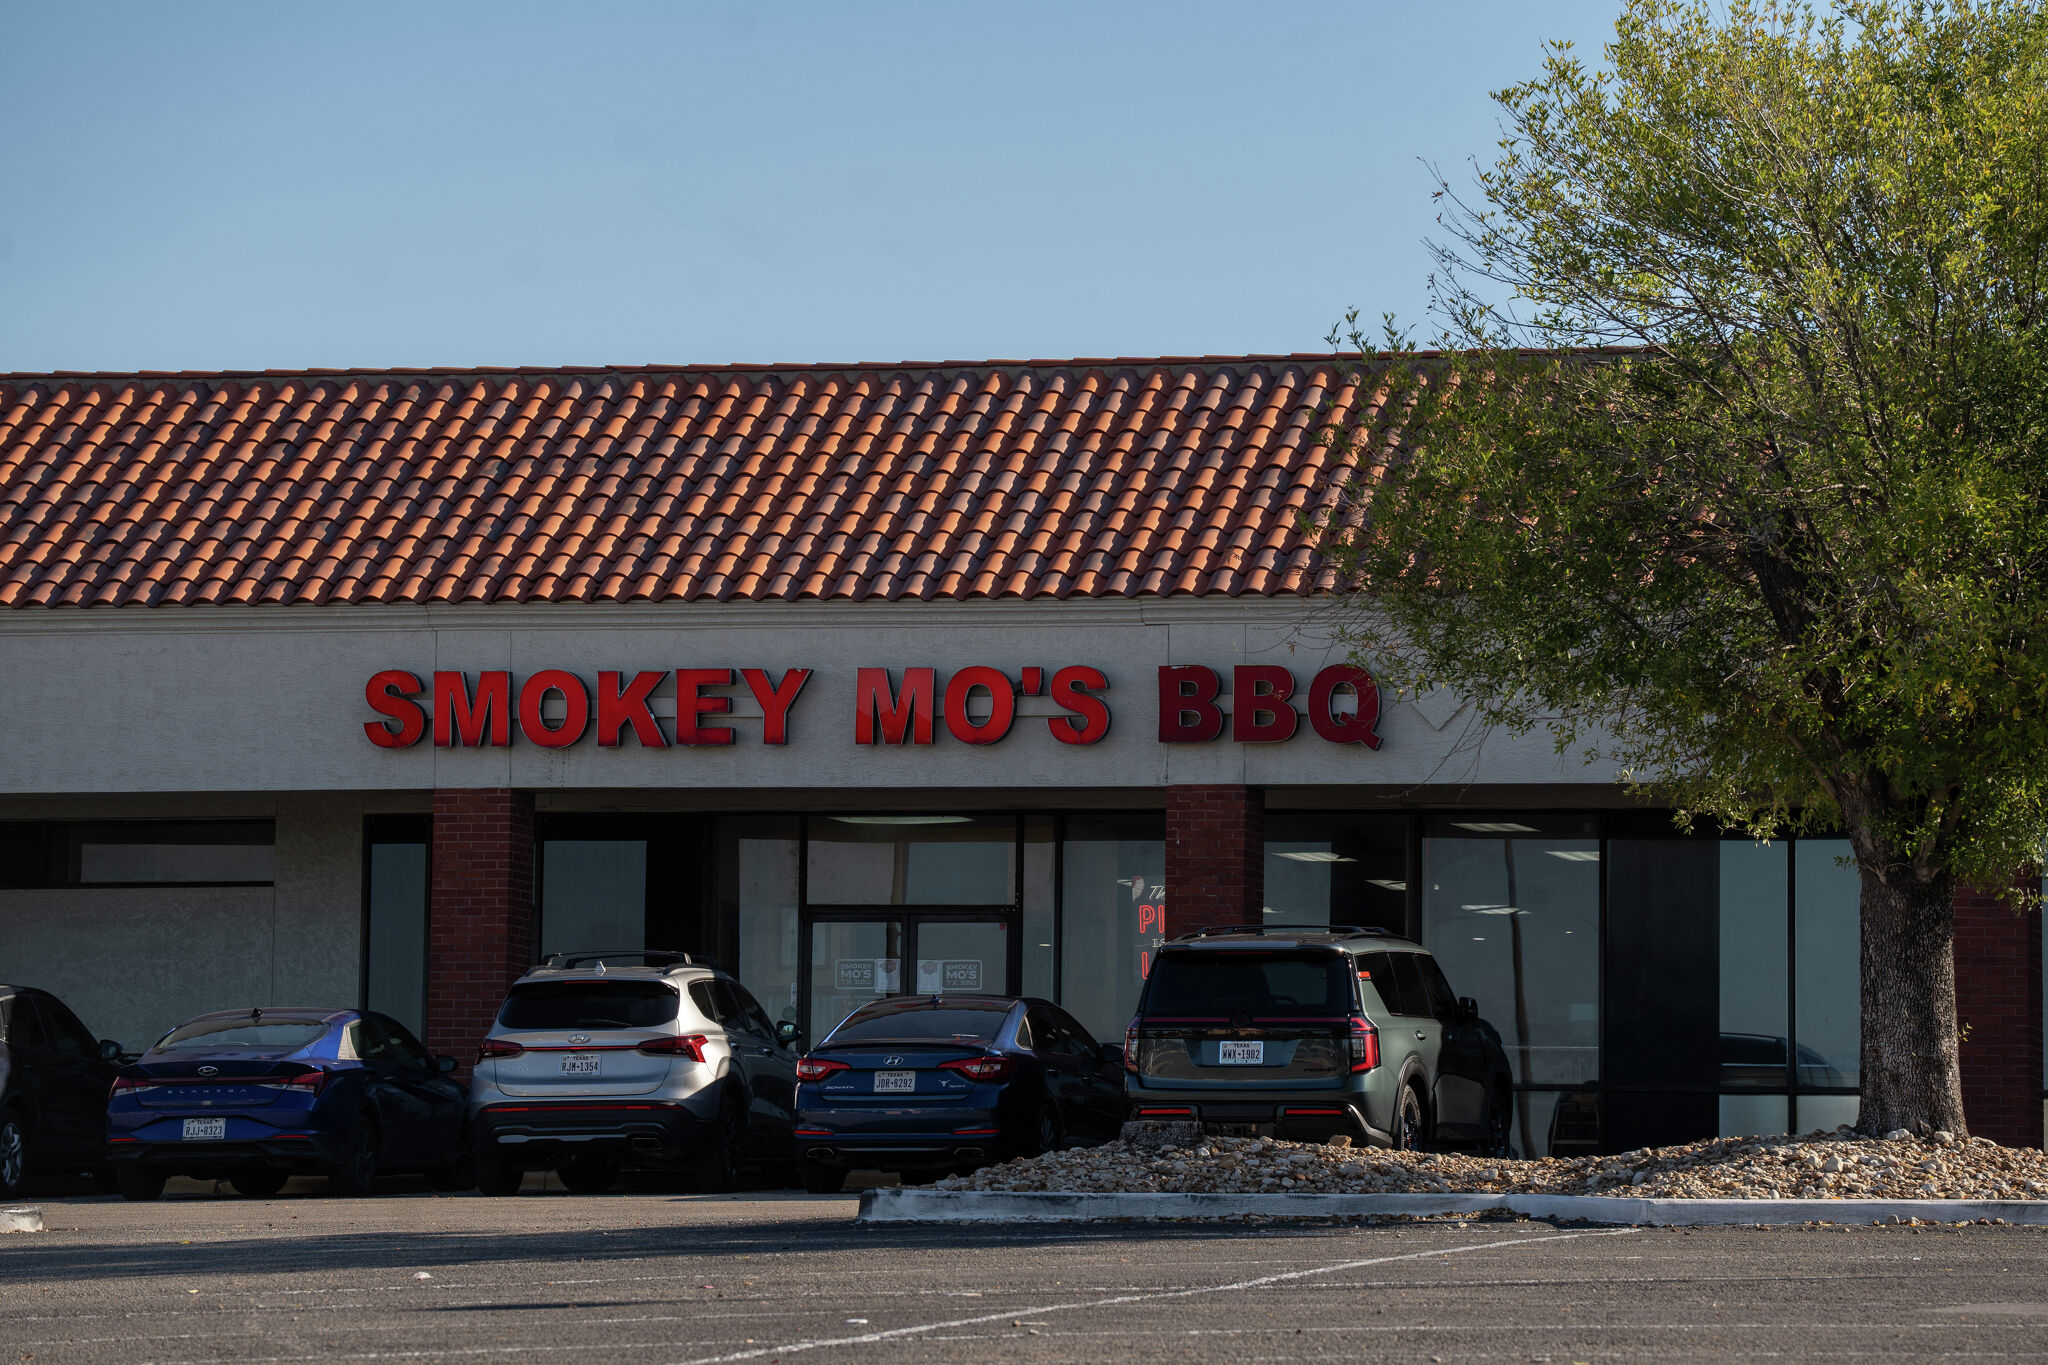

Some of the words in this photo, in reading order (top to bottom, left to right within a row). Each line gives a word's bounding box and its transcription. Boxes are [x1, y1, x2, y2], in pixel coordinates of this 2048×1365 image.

[364, 668, 815, 749] SMOKEY
[855, 665, 1110, 745] MO'S
[1158, 664, 1384, 751] BBQ
[1149, 885, 1165, 900] Th
[1139, 904, 1165, 934] PI
[945, 963, 978, 971] SMOKEY
[840, 969, 873, 979] MO'S
[945, 970, 977, 980] MO'S
